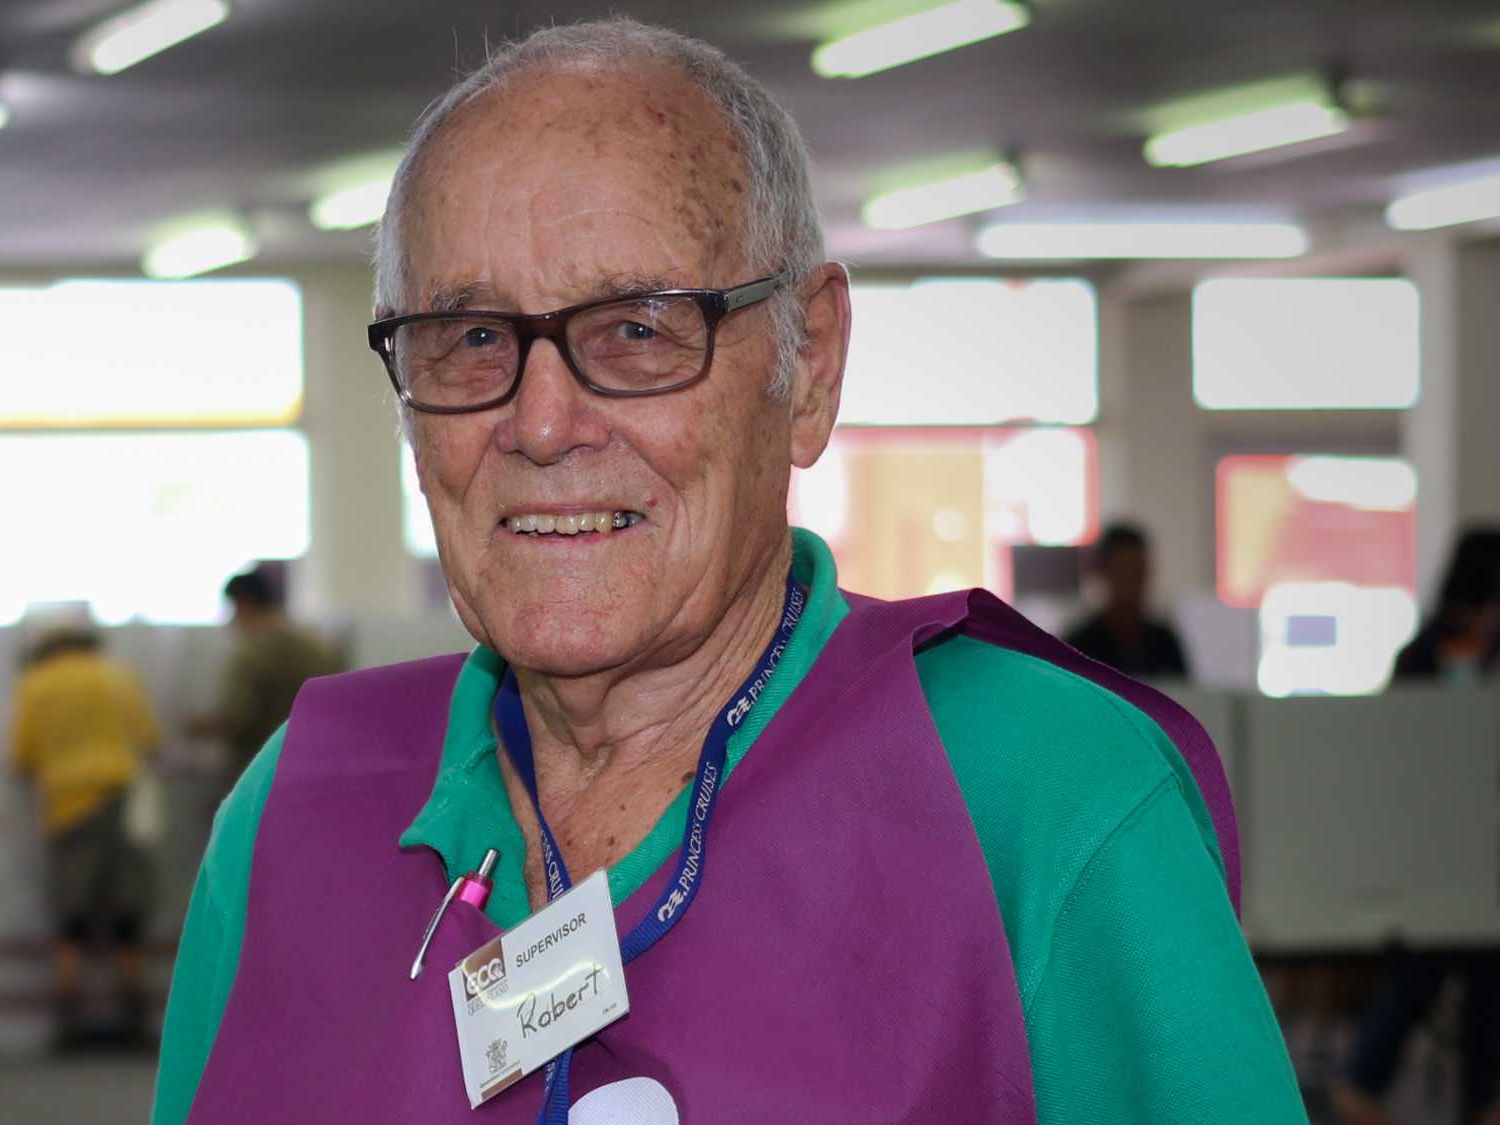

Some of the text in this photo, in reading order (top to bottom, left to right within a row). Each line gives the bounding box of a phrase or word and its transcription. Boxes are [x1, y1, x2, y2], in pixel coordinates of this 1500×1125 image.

[748, 587, 804, 700] PRINCE CRUISES
[678, 761, 717, 889] PRINCESS CRUISES
[548, 861, 565, 899] CRUI
[515, 912, 587, 968] SUPERVISOR
[516, 966, 604, 1039] Robert
